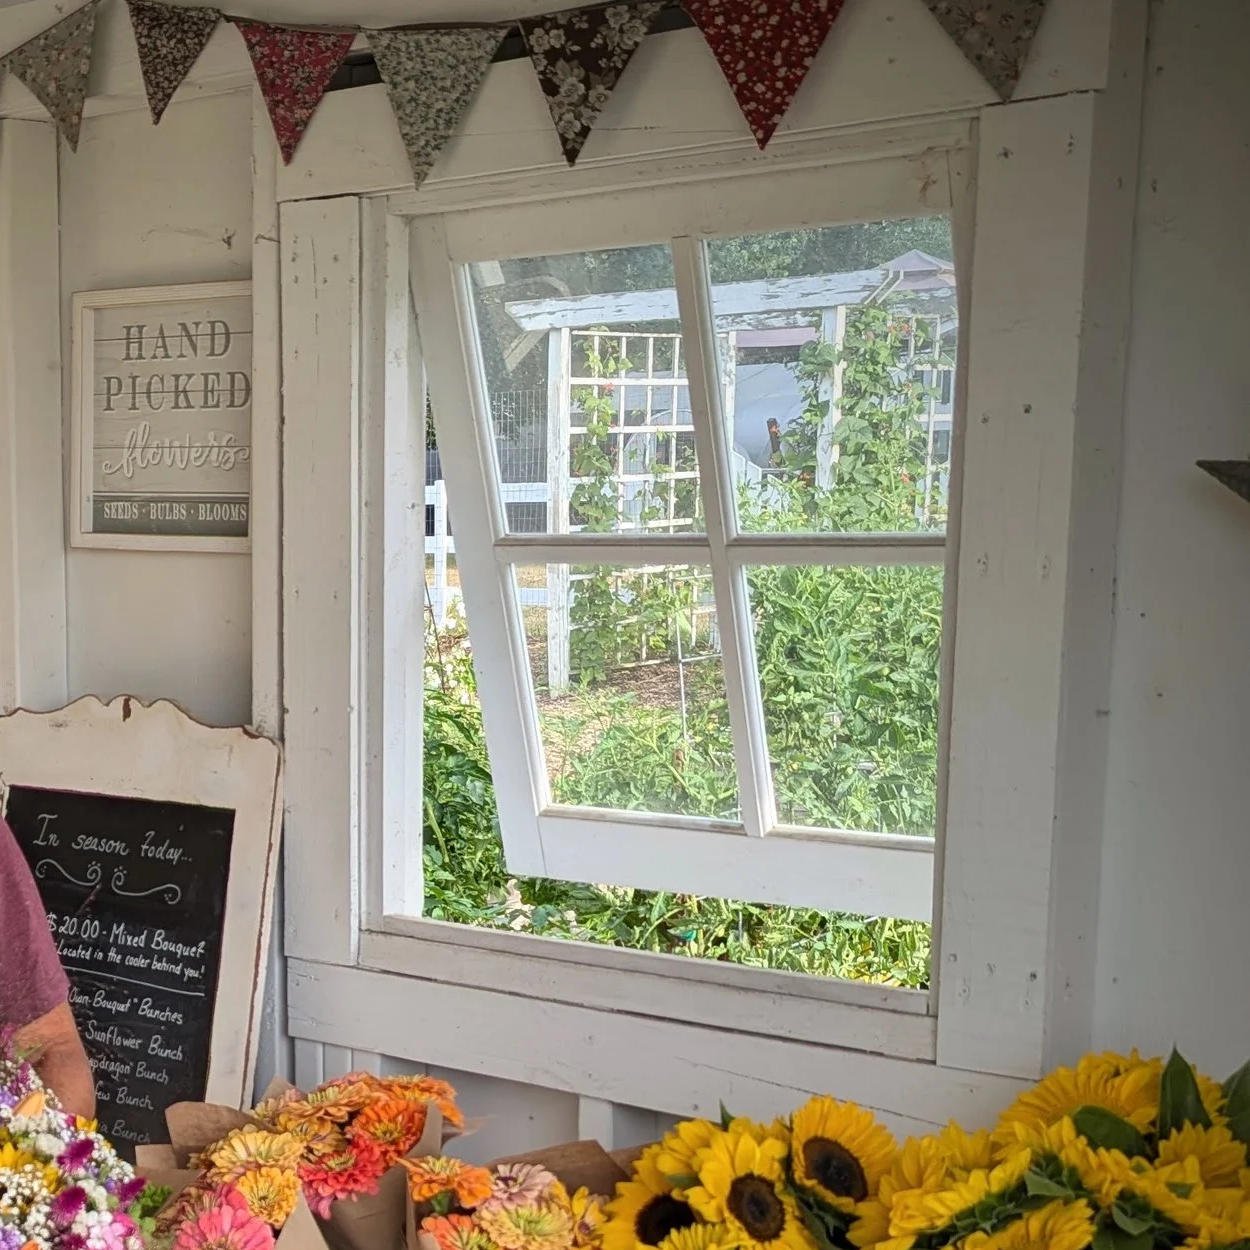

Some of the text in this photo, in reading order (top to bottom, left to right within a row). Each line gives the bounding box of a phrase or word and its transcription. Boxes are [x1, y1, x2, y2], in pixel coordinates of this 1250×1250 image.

[122, 320, 231, 361] HAND
[103, 371, 251, 412] PICKED
[102, 421, 250, 479] flowers
[103, 502, 247, 521] SEEDS BULBS BLOOMS
[33, 814, 59, 847] In
[72, 834, 129, 855] season
[110, 922, 147, 947] Mixed
[151, 929, 206, 958] Bouquet
[94, 947, 103, 961] in
[107, 946, 121, 963] the
[125, 952, 150, 968] cooler
[151, 955, 182, 975] behind
[183, 965, 206, 982] you!
[138, 998, 184, 1025] Bunches
[85, 1020, 183, 1060] Sunflower Bunch
[135, 1061, 169, 1084] Bunch
[116, 1086, 154, 1110] Bunch
[112, 1119, 151, 1143] Bunch
